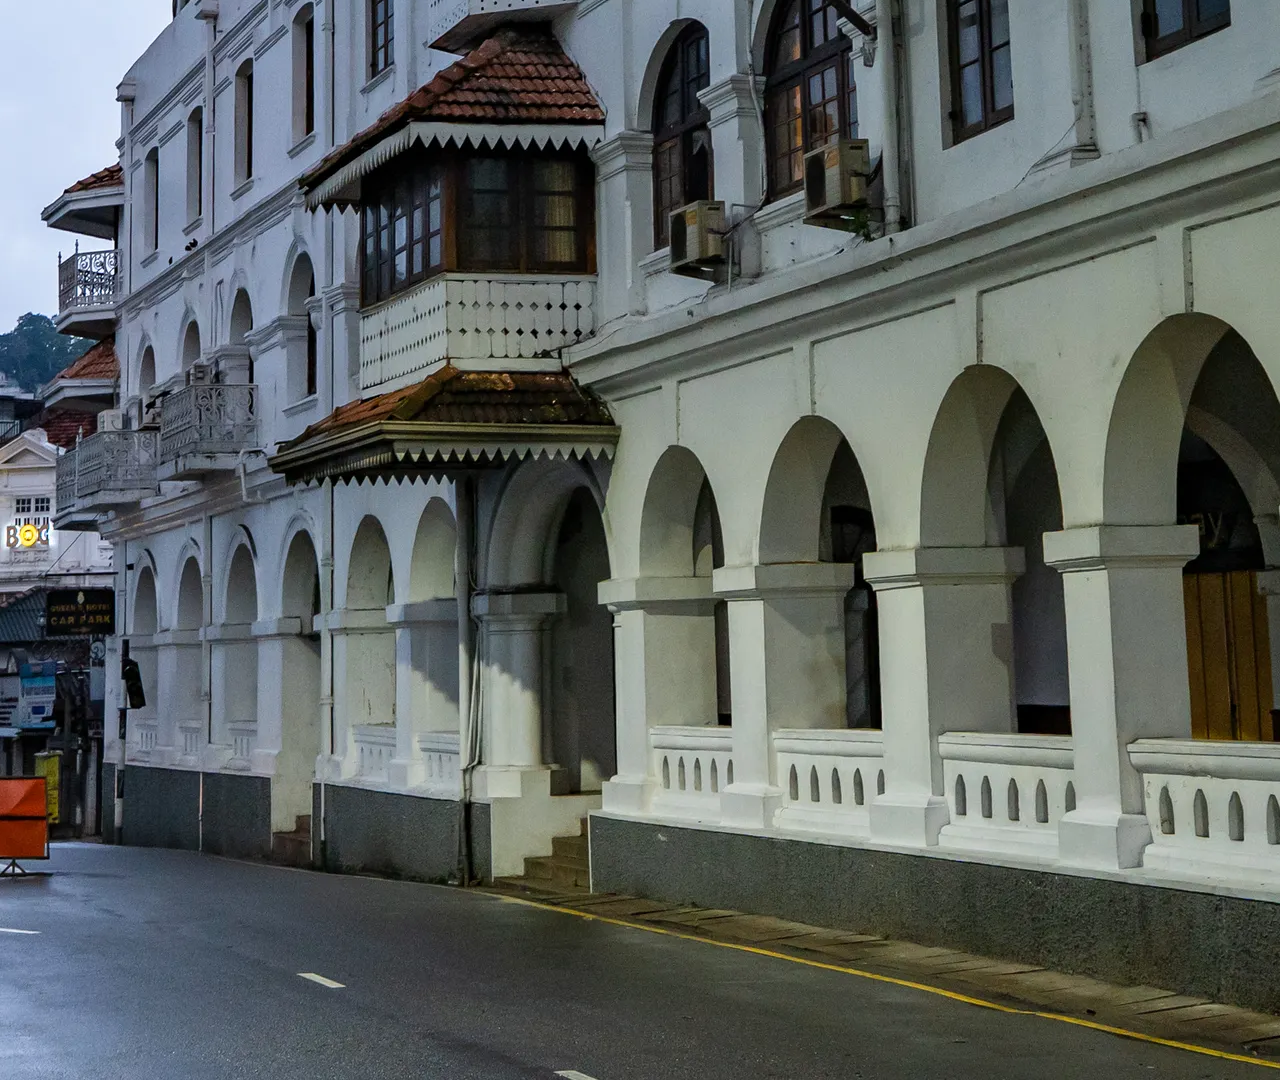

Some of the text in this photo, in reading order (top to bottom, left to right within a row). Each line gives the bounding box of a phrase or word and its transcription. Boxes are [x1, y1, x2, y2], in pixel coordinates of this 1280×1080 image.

[86, 603, 111, 611] HOTEL
[51, 615, 111, 625] CAR PARK
